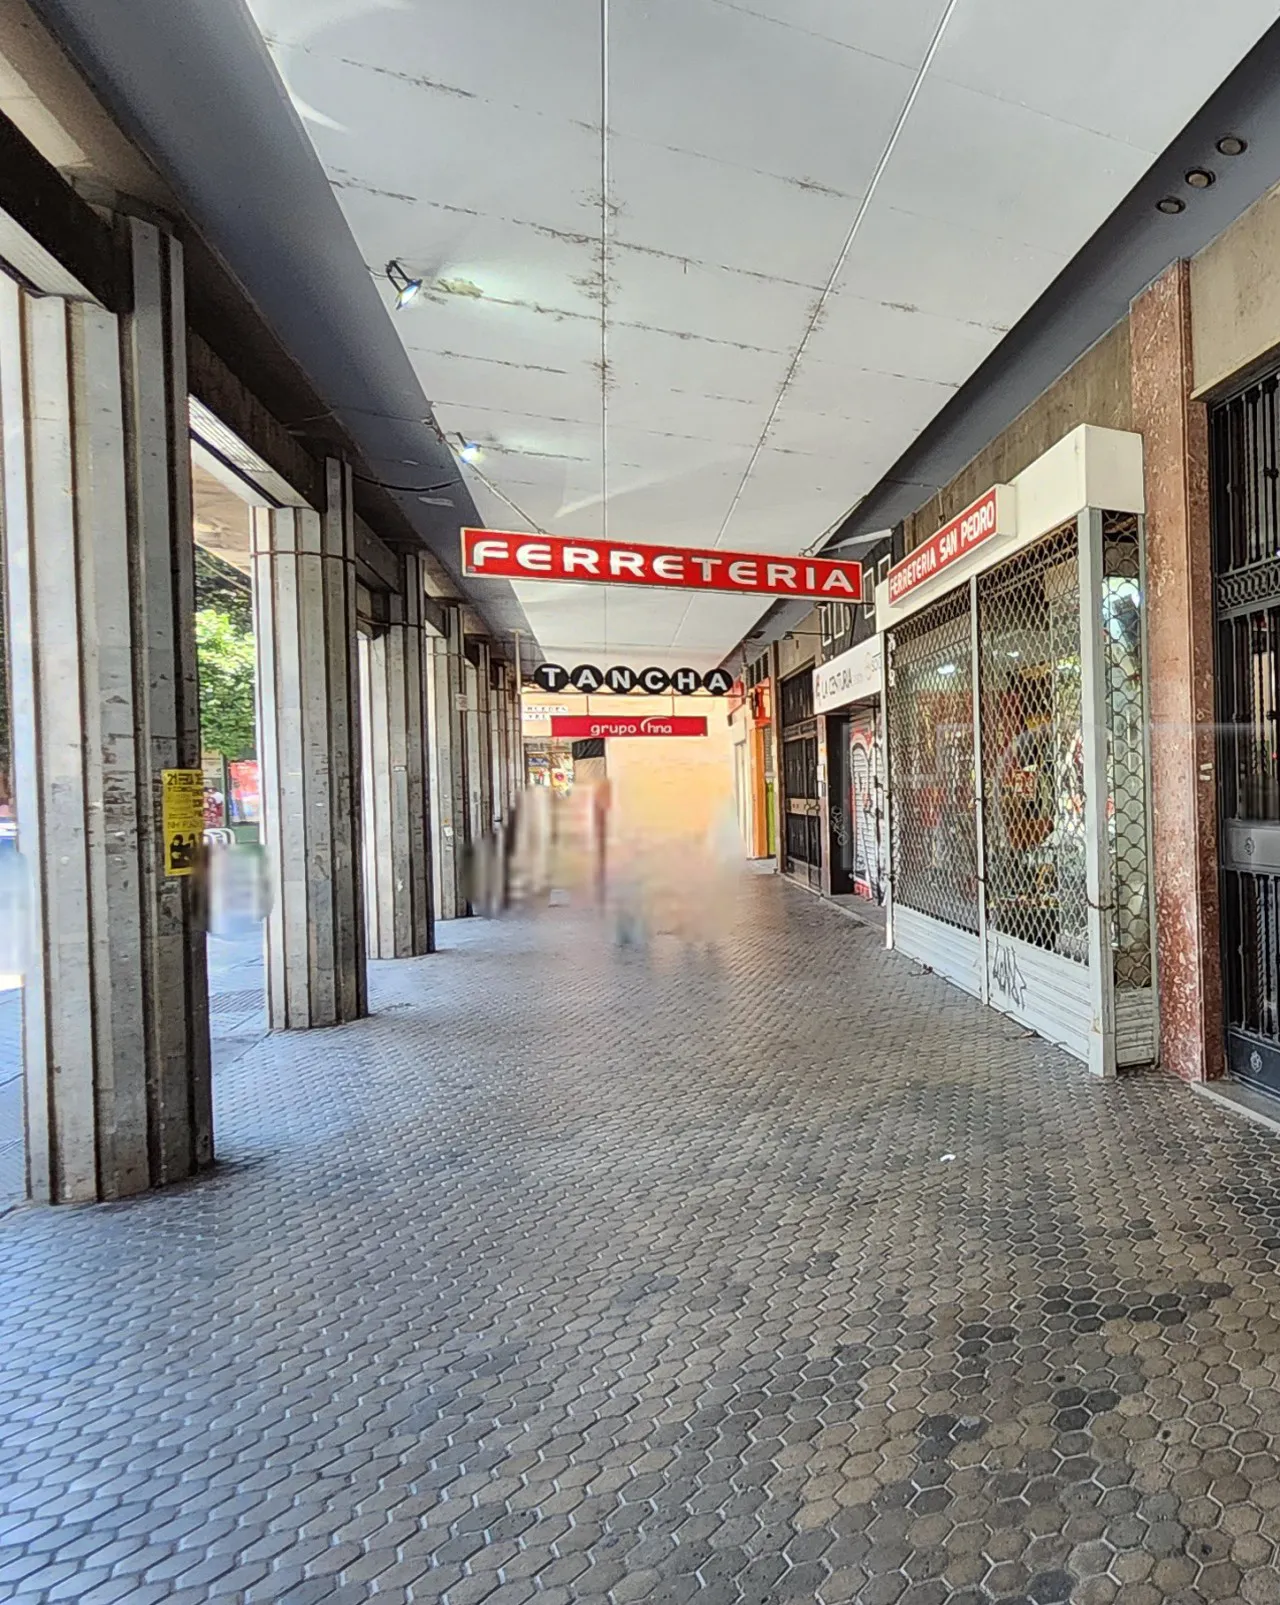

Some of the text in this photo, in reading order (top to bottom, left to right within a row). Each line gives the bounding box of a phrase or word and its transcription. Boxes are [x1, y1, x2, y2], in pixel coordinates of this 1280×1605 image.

[473, 540, 854, 593] FERRETERIA
[888, 500, 995, 600] FERRETERIA SAN PEDRO
[540, 666, 731, 692] TANCHA
[590, 724, 637, 736] grupo
